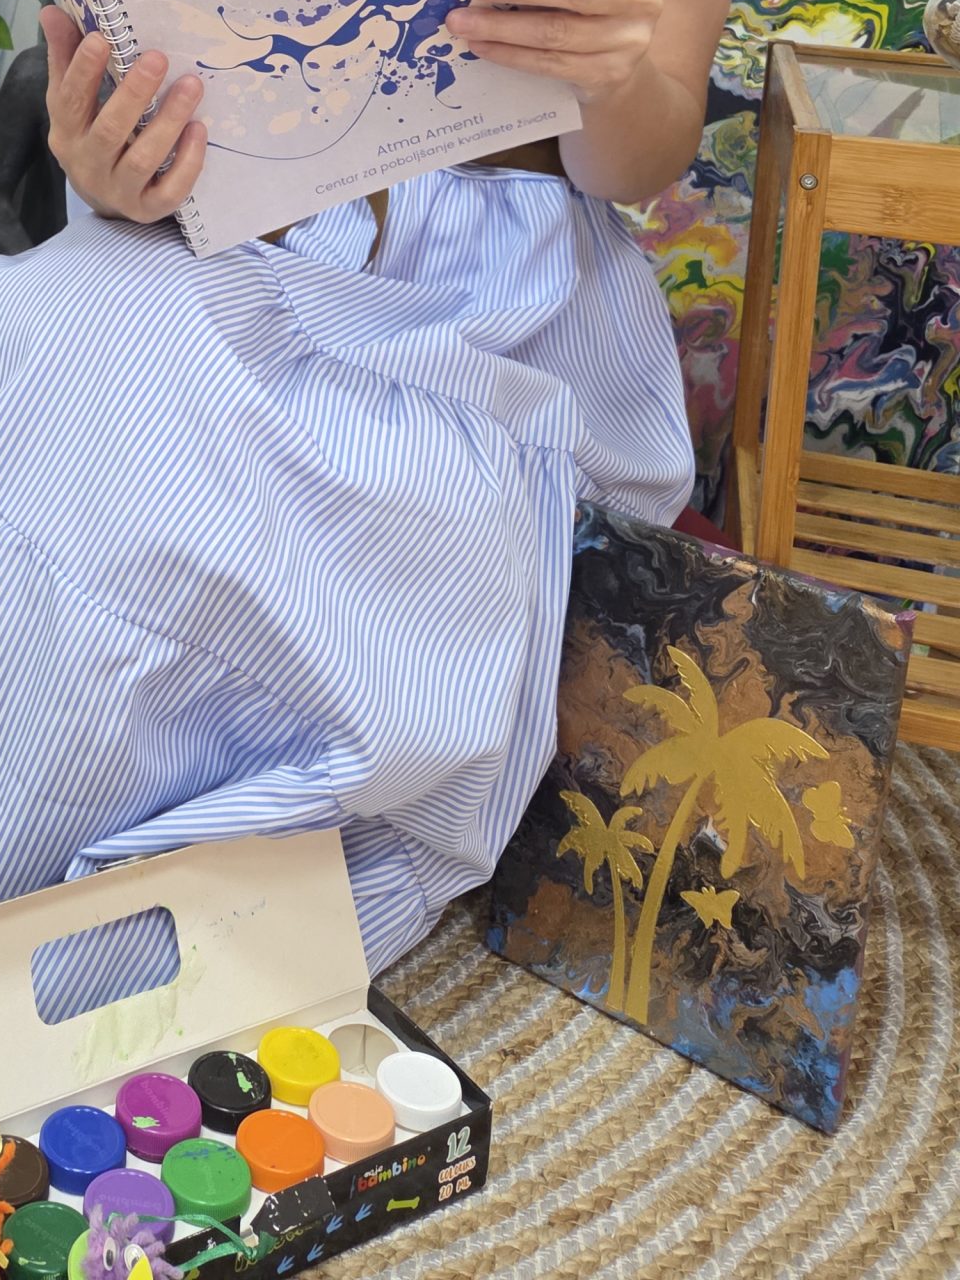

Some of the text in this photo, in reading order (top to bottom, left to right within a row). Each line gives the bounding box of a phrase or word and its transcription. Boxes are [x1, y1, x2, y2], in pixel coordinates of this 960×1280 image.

[376, 112, 484, 157] Atma Amenti
[314, 172, 359, 196] Centar
[363, 166, 378, 179] za
[457, 121, 514, 147] kvalitete
[446, 1126, 472, 1163] 12
[357, 1154, 427, 1192] bambino
[438, 1183, 454, 1202] 20
